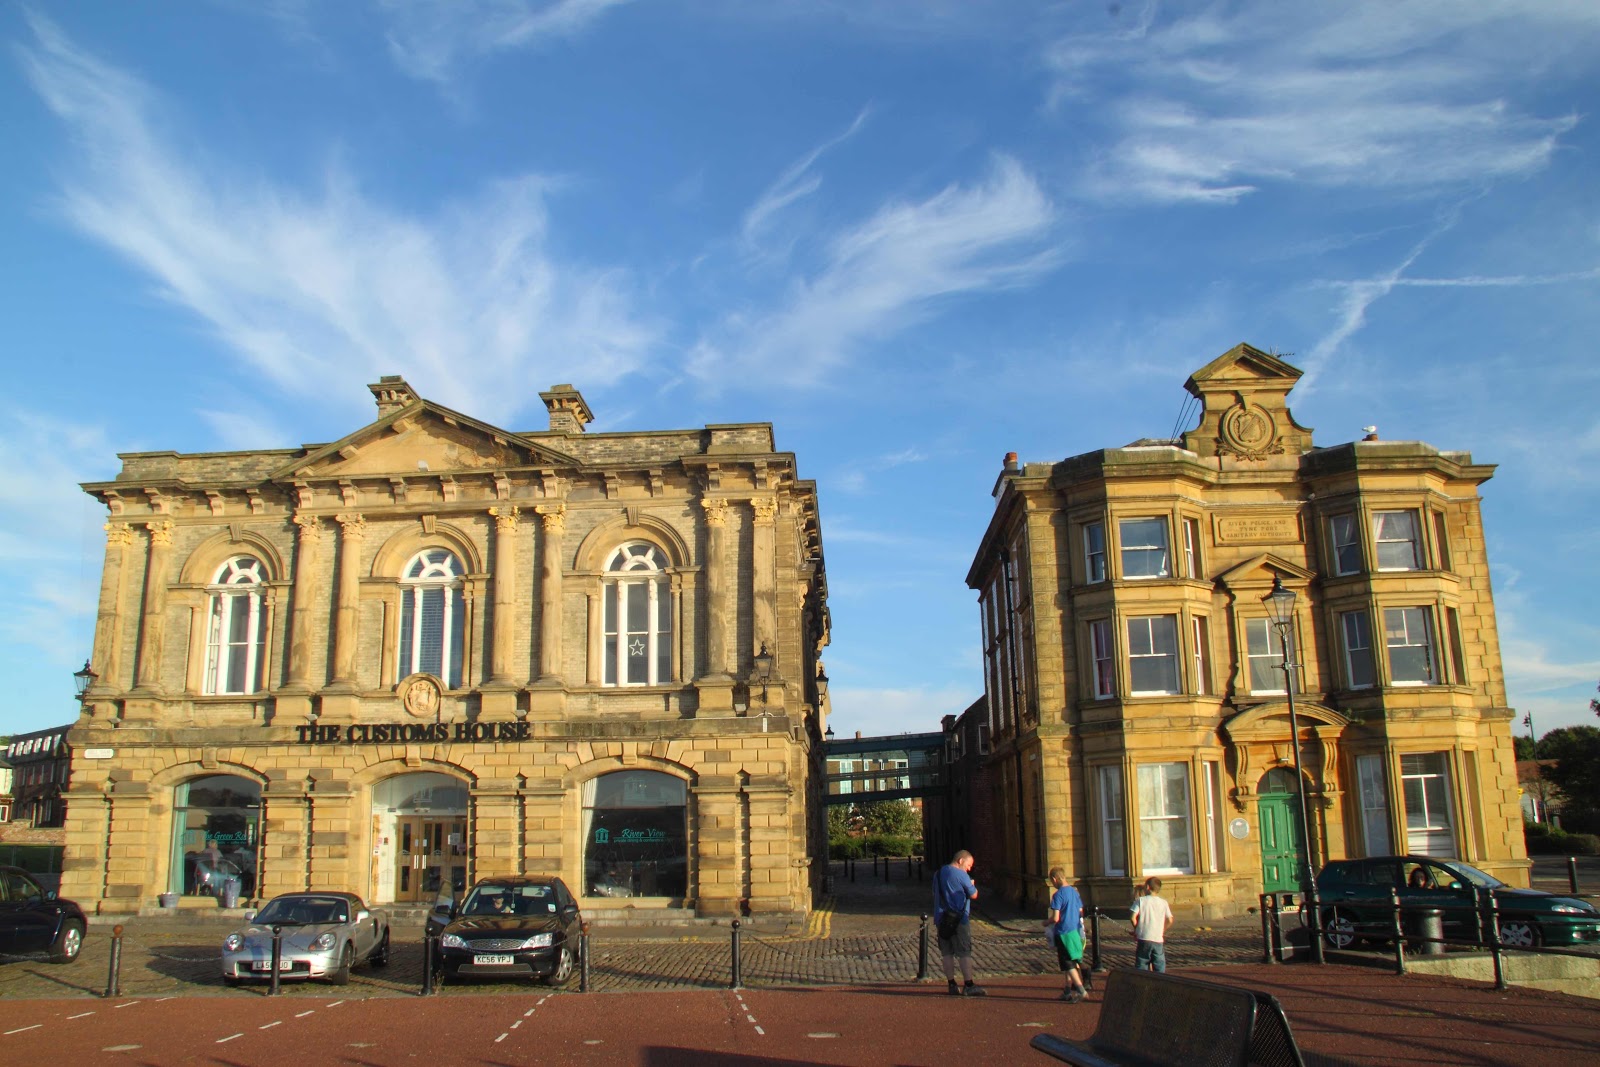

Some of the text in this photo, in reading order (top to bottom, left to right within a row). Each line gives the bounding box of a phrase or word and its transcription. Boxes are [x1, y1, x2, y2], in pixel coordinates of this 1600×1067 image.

[296, 721, 532, 744] THE CUSTOMS HOUSE
[214, 831, 233, 840] Green
[621, 828, 666, 838] River View
